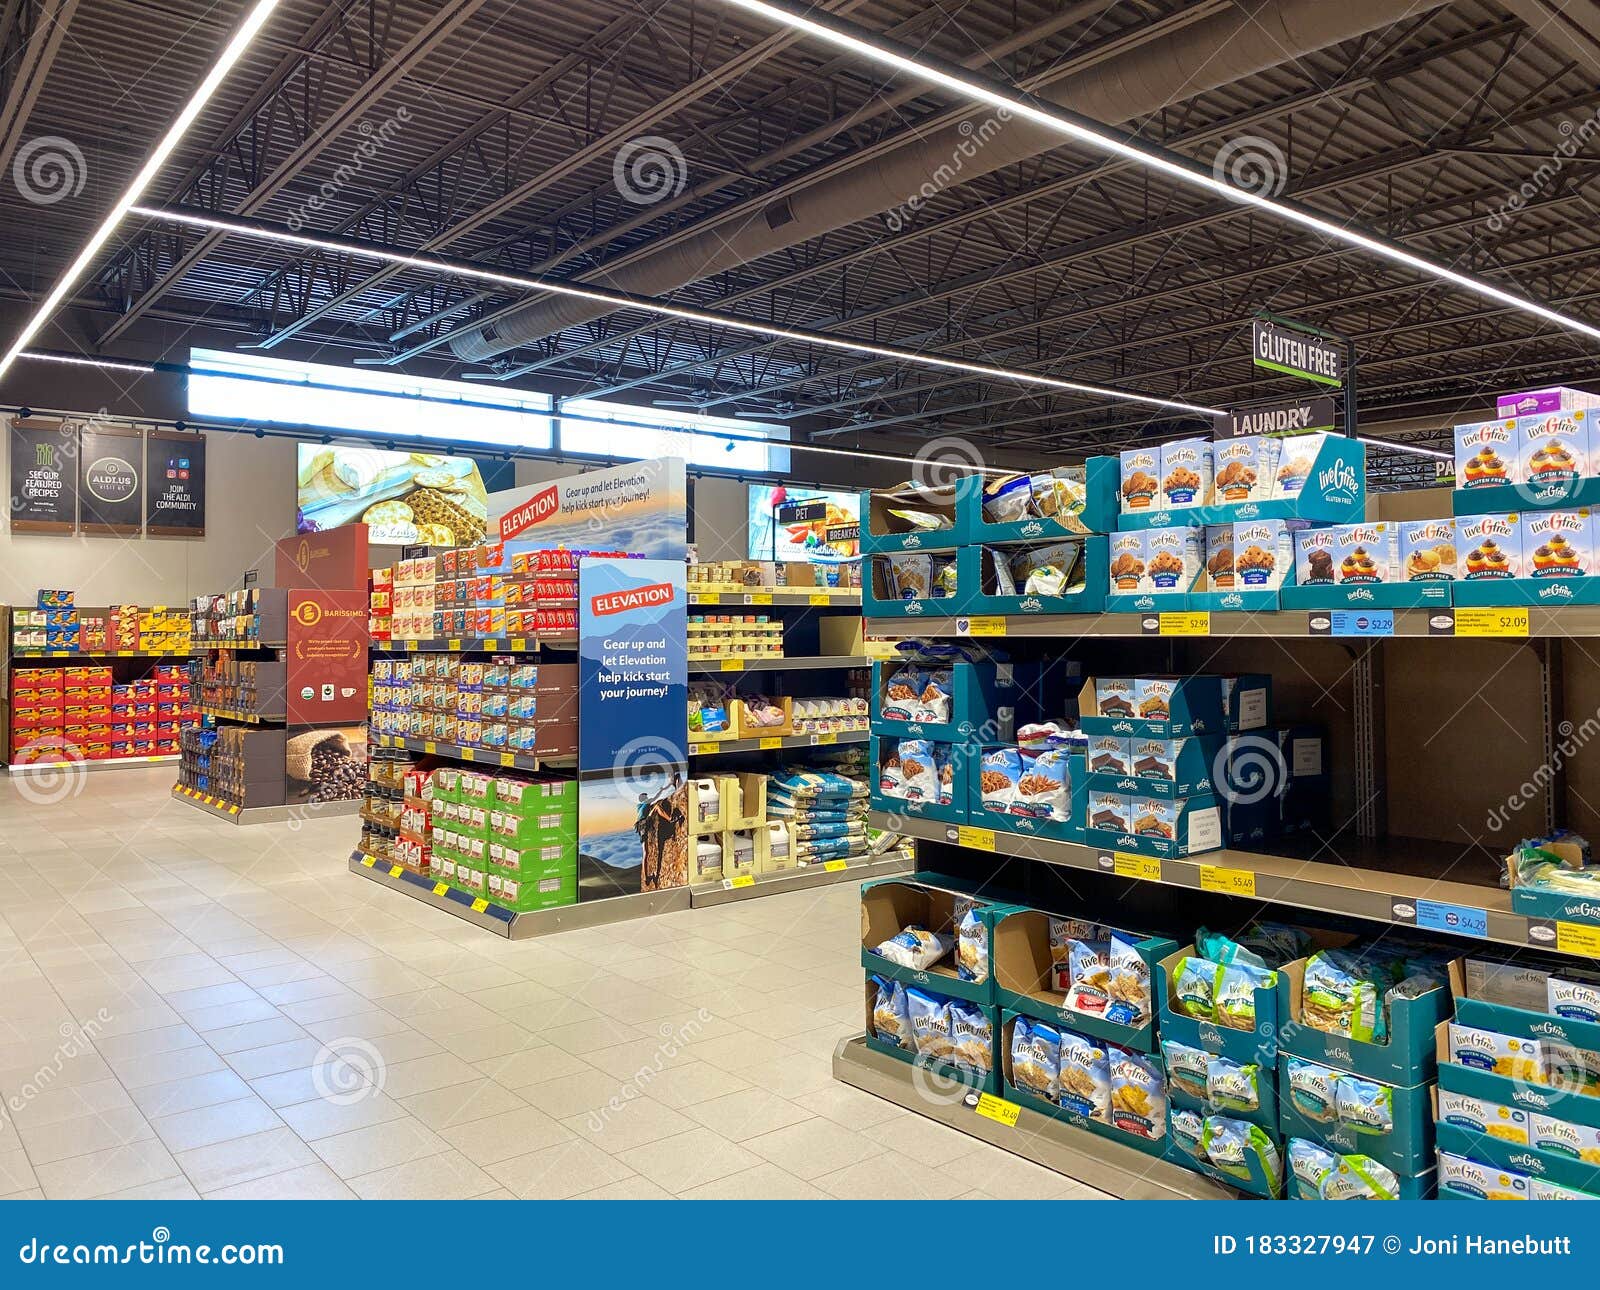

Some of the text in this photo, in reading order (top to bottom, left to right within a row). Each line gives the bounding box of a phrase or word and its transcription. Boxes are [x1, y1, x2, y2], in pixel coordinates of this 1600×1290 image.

[1259, 331, 1337, 377] GLUTEN FREE
[1233, 406, 1311, 436] LAUNDRY
[1528, 416, 1578, 439] liveGfree
[1463, 426, 1509, 447] liveGfree
[29, 471, 59, 480] SEE OUR
[1319, 458, 1359, 495] liveGfree
[26, 479, 62, 489] FEATURED
[169, 485, 184, 493] JOIN
[565, 476, 645, 498] Gear up and let Elevation
[29, 488, 59, 498] RECIPES
[162, 493, 191, 502] THE ALDI
[156, 501, 197, 511] COMMUNITY
[561, 501, 575, 515] help
[575, 498, 588, 510] kick
[588, 496, 605, 508] start
[620, 488, 650, 504] journey!
[502, 492, 556, 536] ELEVATION
[795, 508, 808, 520] PET
[1464, 517, 1512, 538] liveGfree
[1531, 512, 1583, 534] liveGfree
[1339, 527, 1380, 546] liveGfree
[596, 587, 670, 612] ELEVATION
[1190, 619, 1209, 629] $2.99
[1371, 618, 1393, 630] $2.29
[1500, 616, 1527, 628] $2.09
[603, 638, 666, 652] Gear up and
[602, 654, 666, 666] let Elevation
[598, 671, 670, 684] help kick start
[600, 685, 668, 701] your journey!
[1233, 877, 1253, 888] $5.49
[1461, 917, 1486, 931] $4.29
[1456, 1032, 1496, 1051] liveGfree
[1001, 1105, 1018, 1121] $2.49
[1446, 1098, 1486, 1119] liveGfree
[1536, 1121, 1581, 1145] liveGfree
[1446, 1164, 1487, 1186] liveGfree
